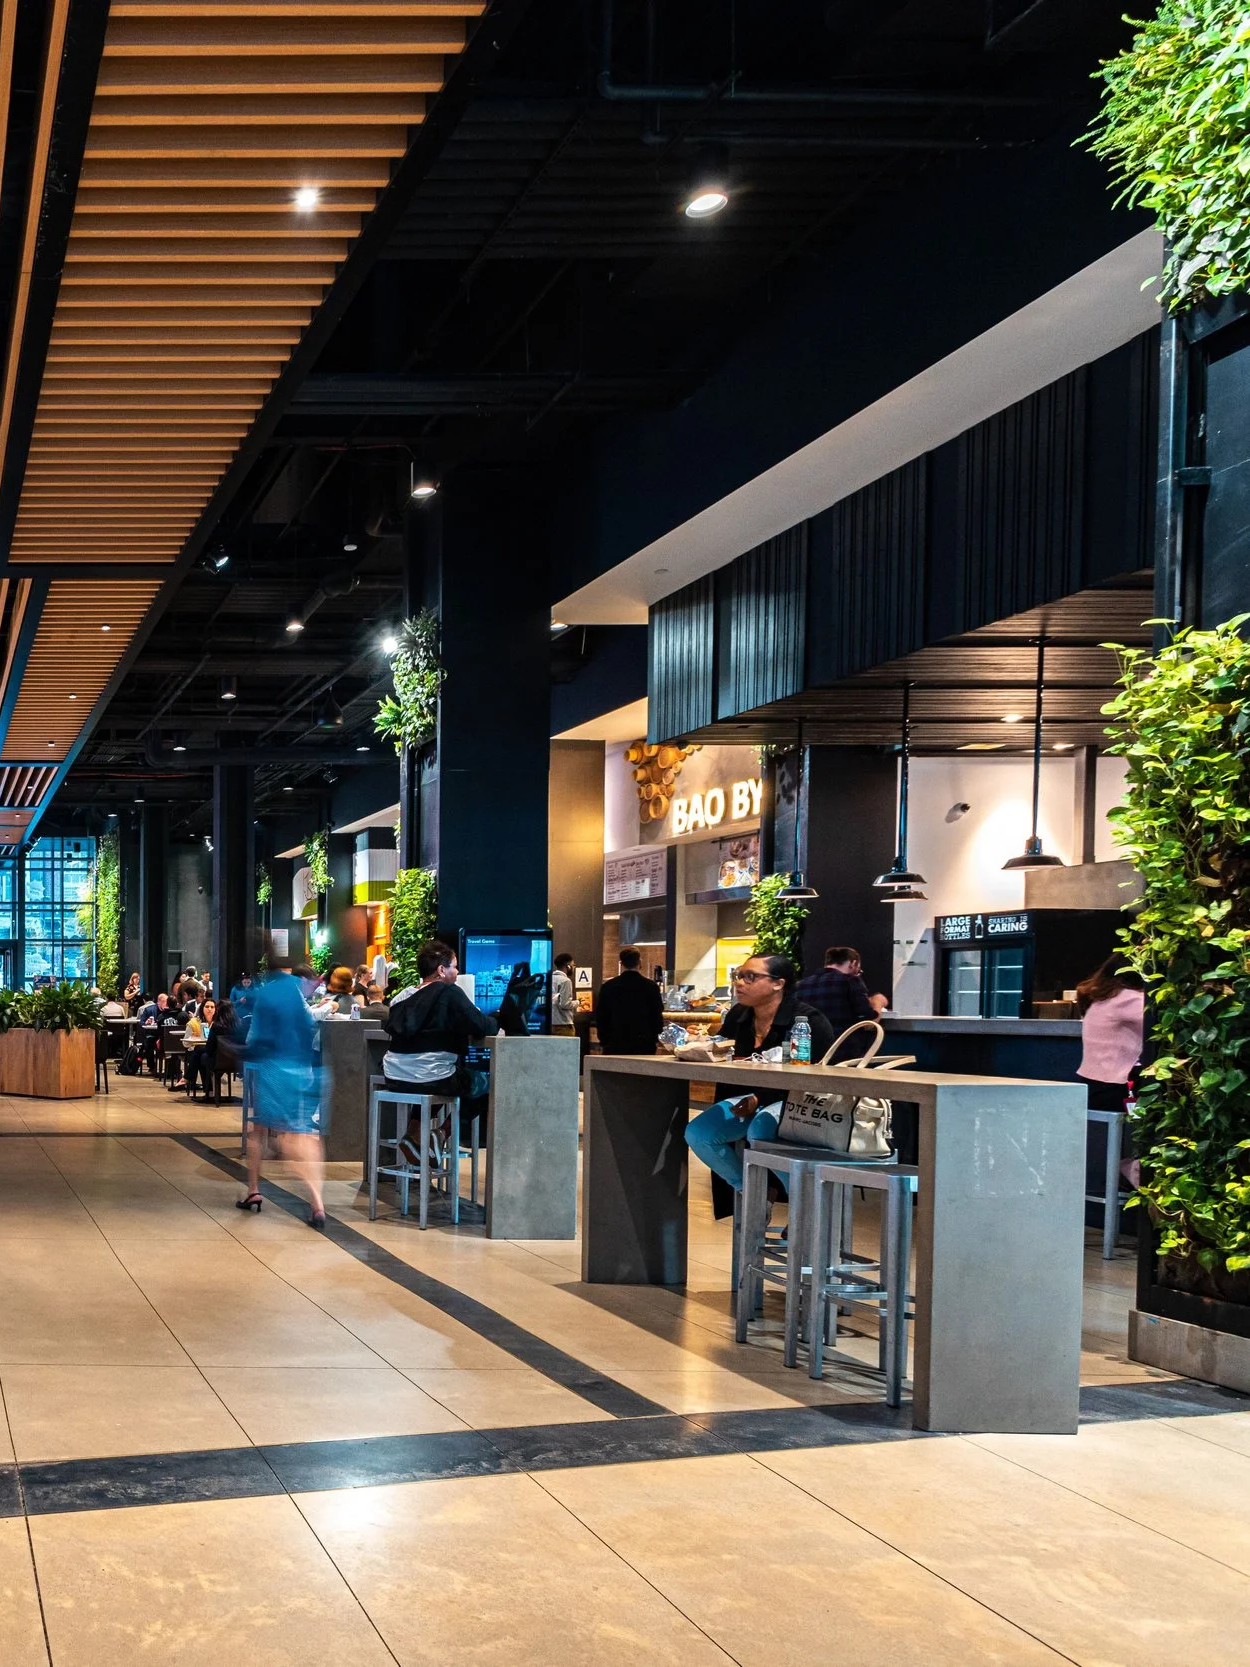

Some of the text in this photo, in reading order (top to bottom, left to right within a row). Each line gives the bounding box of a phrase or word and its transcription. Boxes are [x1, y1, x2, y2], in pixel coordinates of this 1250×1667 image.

[672, 777, 763, 834] BAO BY
[940, 916, 971, 927] LARGE
[988, 916, 1017, 925] SHARING
[940, 925, 971, 934] FORMAT
[987, 921, 1028, 933] CARING
[578, 970, 589, 982] A
[804, 1094, 828, 1107] THE
[786, 1101, 843, 1123] TOTE BAG
